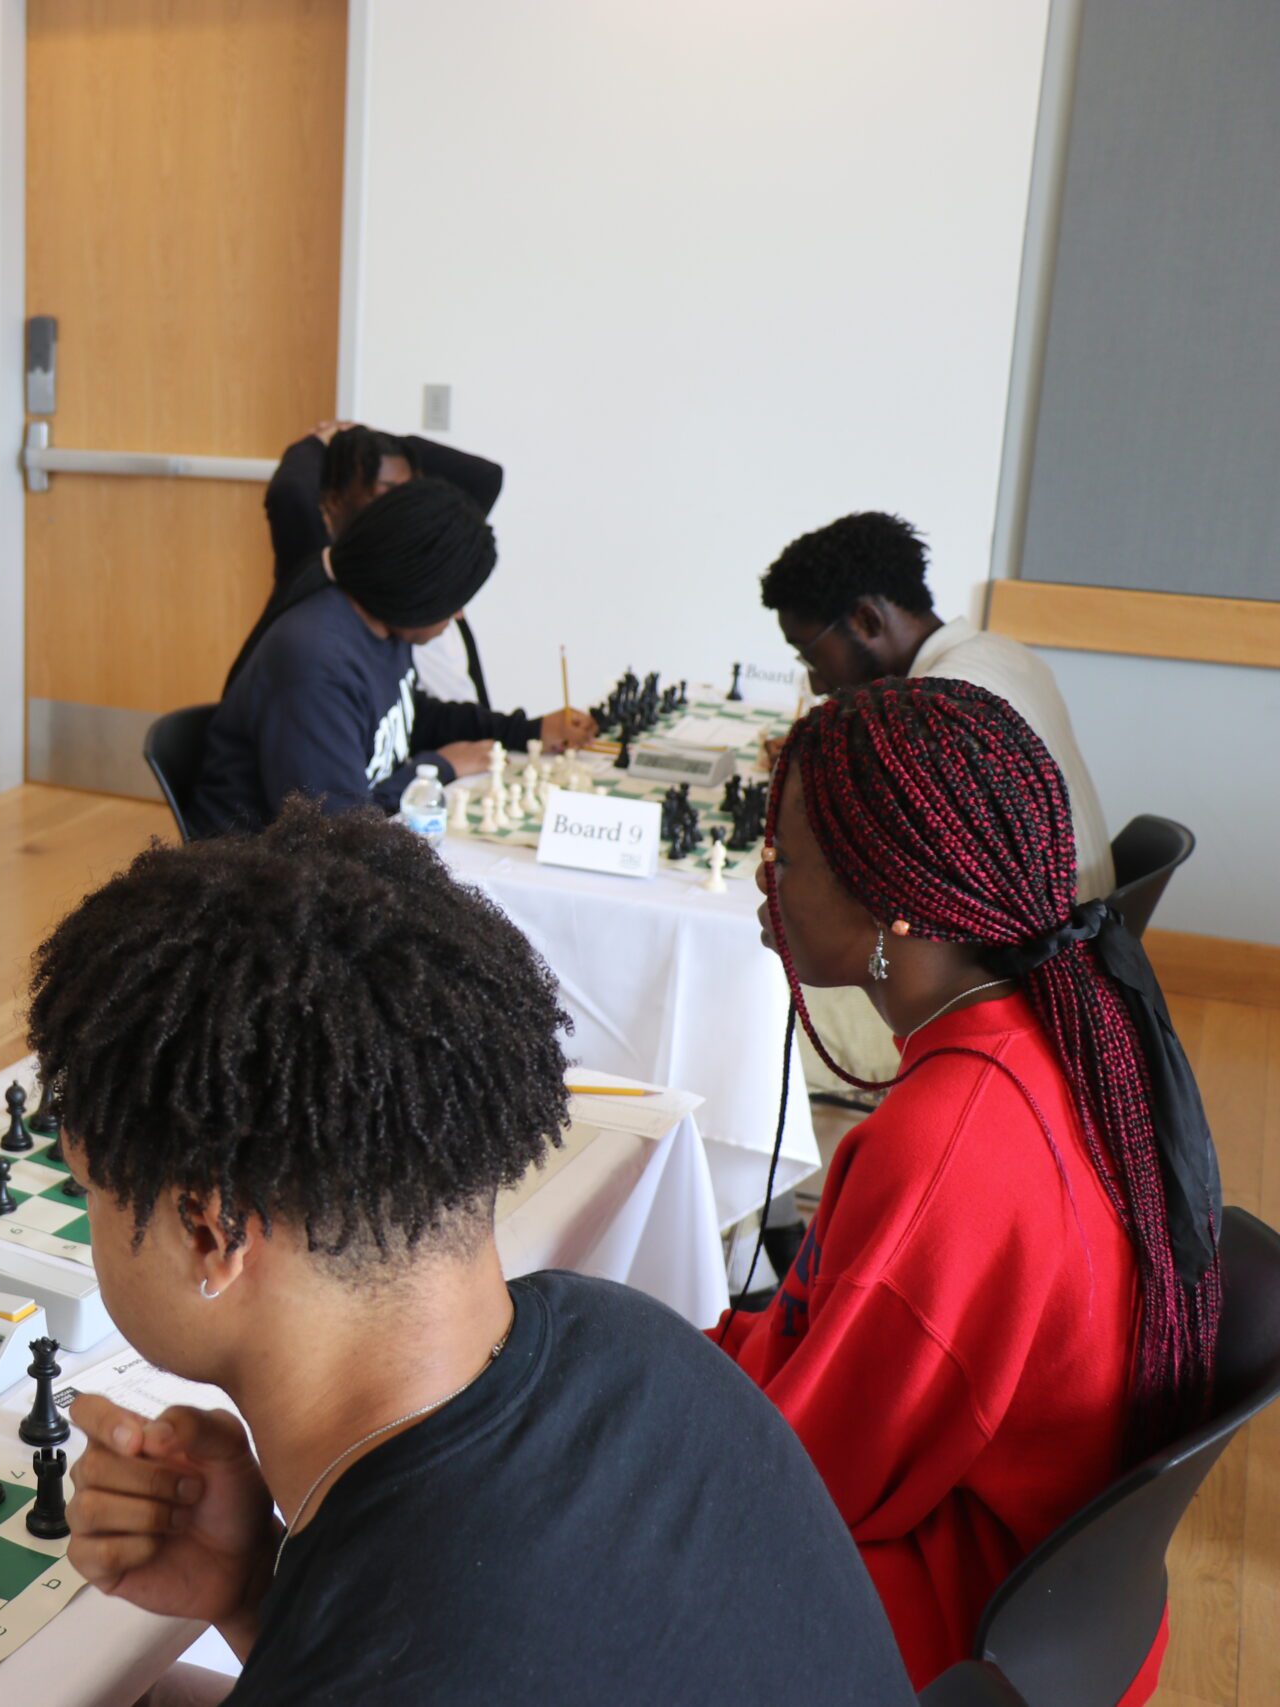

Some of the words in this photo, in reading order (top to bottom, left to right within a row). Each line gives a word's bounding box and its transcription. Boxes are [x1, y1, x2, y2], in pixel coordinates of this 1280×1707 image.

[746, 663, 795, 685] Board
[553, 813, 623, 841] Board
[628, 823, 644, 846] 9
